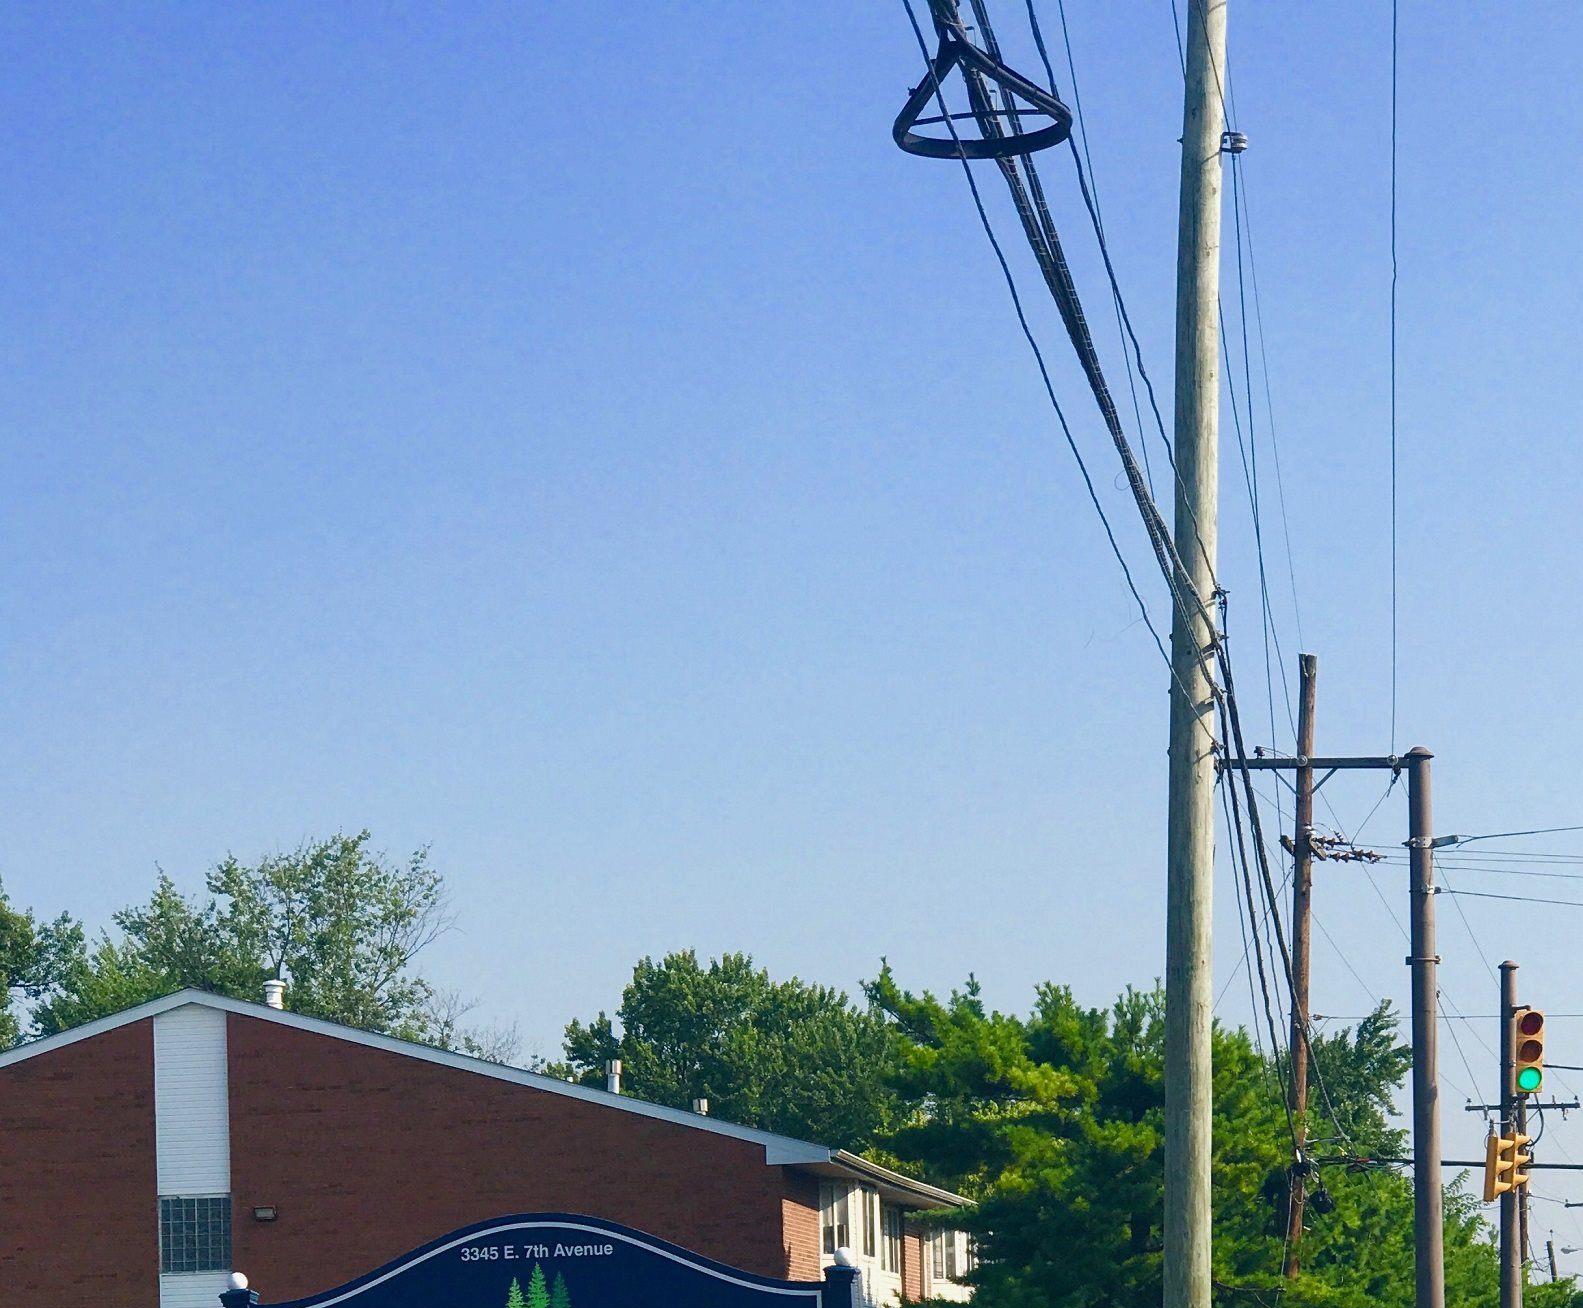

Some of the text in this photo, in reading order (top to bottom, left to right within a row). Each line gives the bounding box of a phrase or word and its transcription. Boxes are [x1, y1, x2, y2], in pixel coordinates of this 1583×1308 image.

[461, 1243, 614, 1261] 3345 E. 7th Avenue
